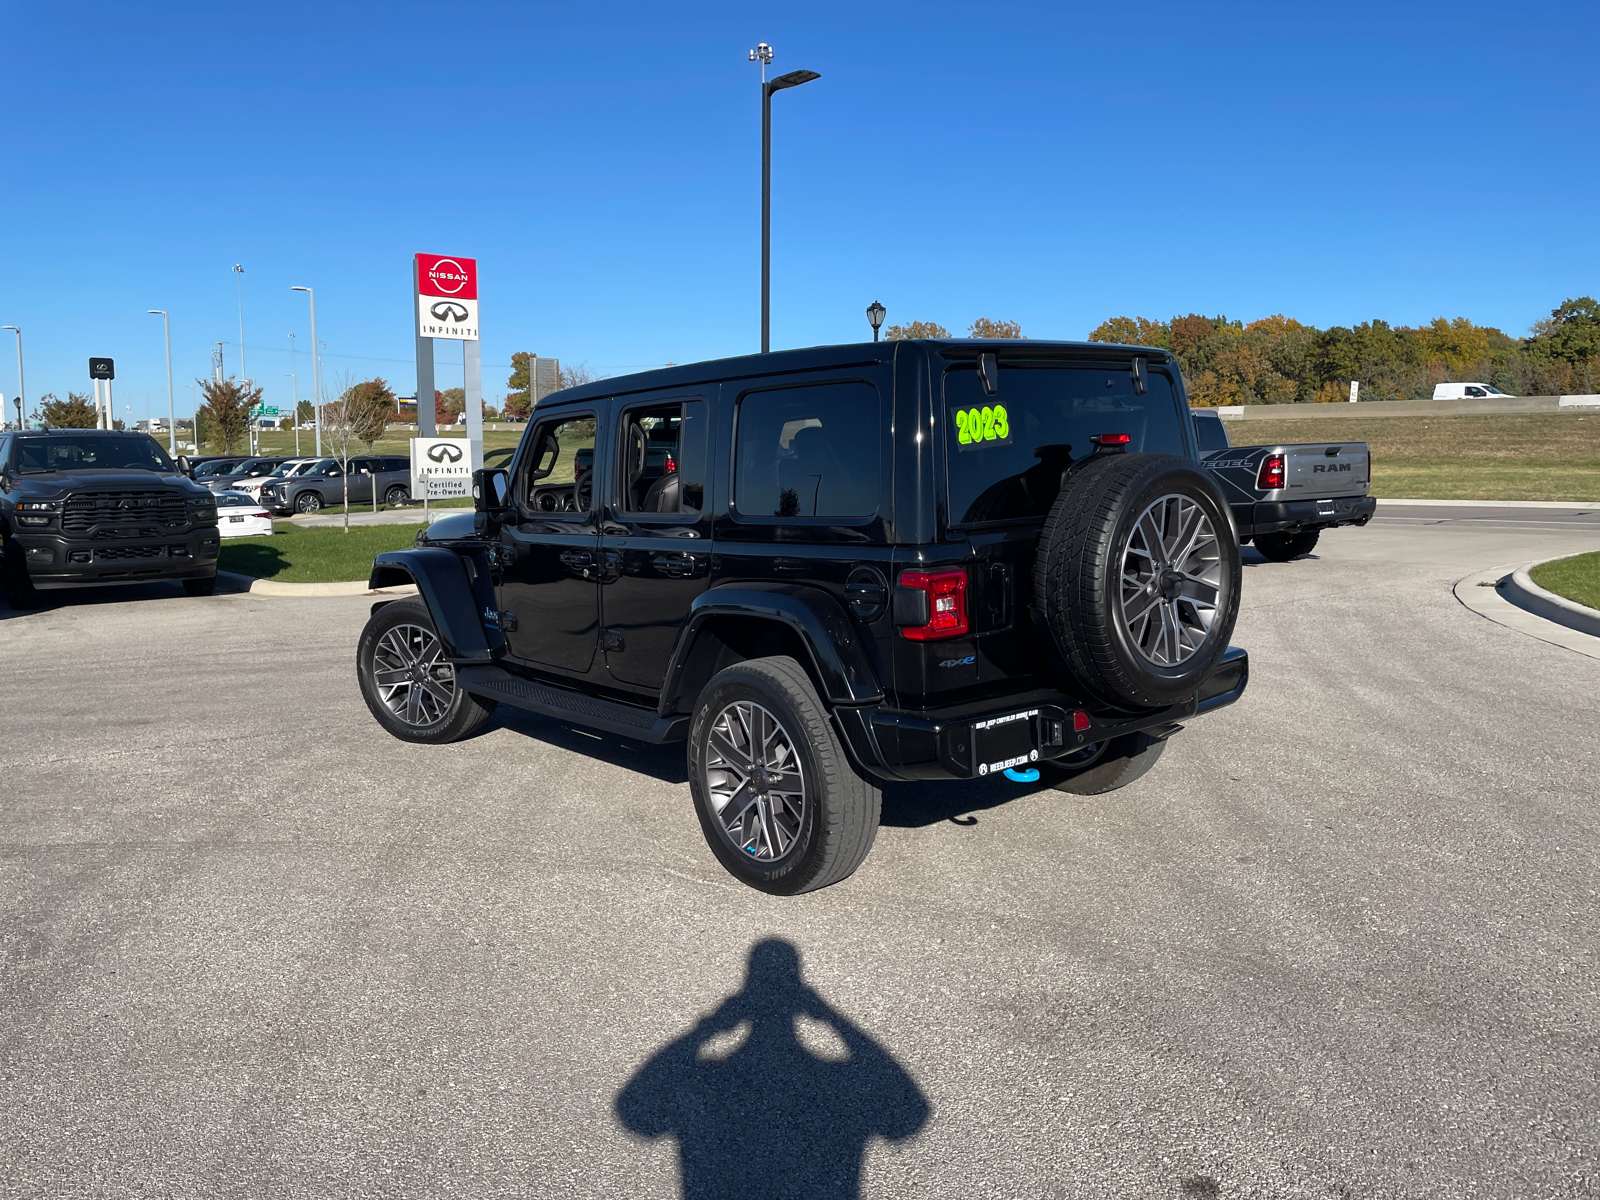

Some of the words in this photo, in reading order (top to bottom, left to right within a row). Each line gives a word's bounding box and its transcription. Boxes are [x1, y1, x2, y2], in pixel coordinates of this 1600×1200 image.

[428, 271, 468, 281] NISSAN
[423, 325, 477, 336] INFINITI
[956, 405, 1009, 444] 2023
[1313, 463, 1351, 473] RAM
